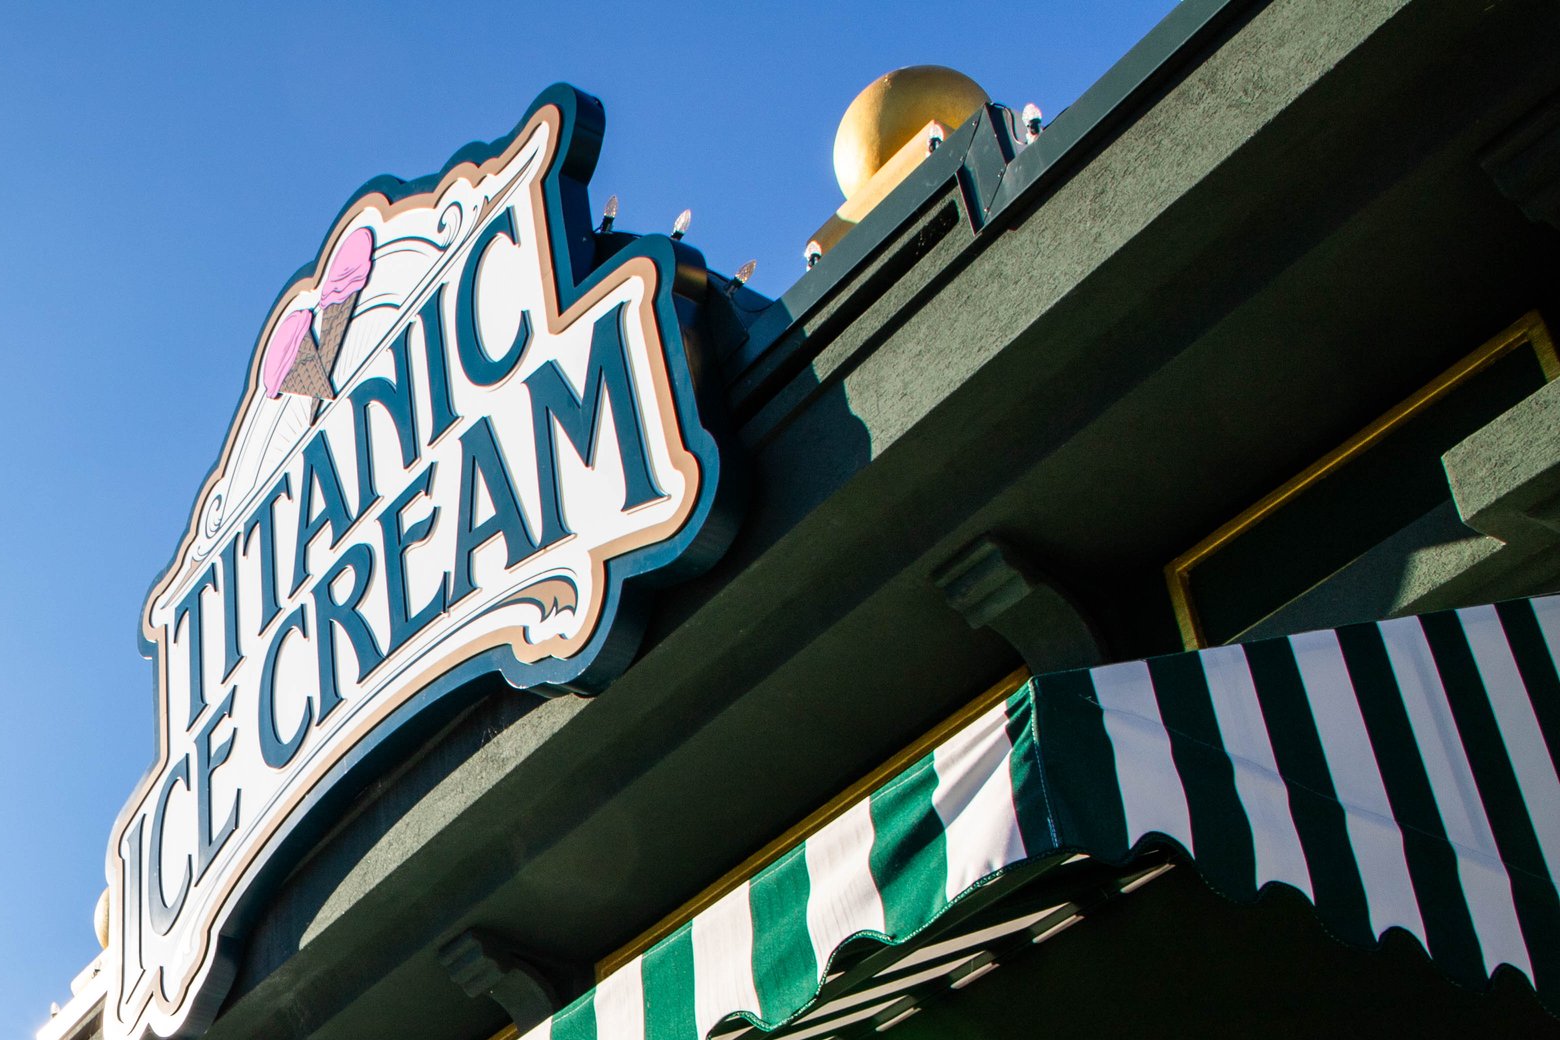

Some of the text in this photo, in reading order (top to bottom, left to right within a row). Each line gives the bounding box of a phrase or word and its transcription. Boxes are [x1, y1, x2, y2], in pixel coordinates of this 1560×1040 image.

[125, 299, 672, 1004] ICE CREAM
[174, 205, 535, 732] TITANIC
